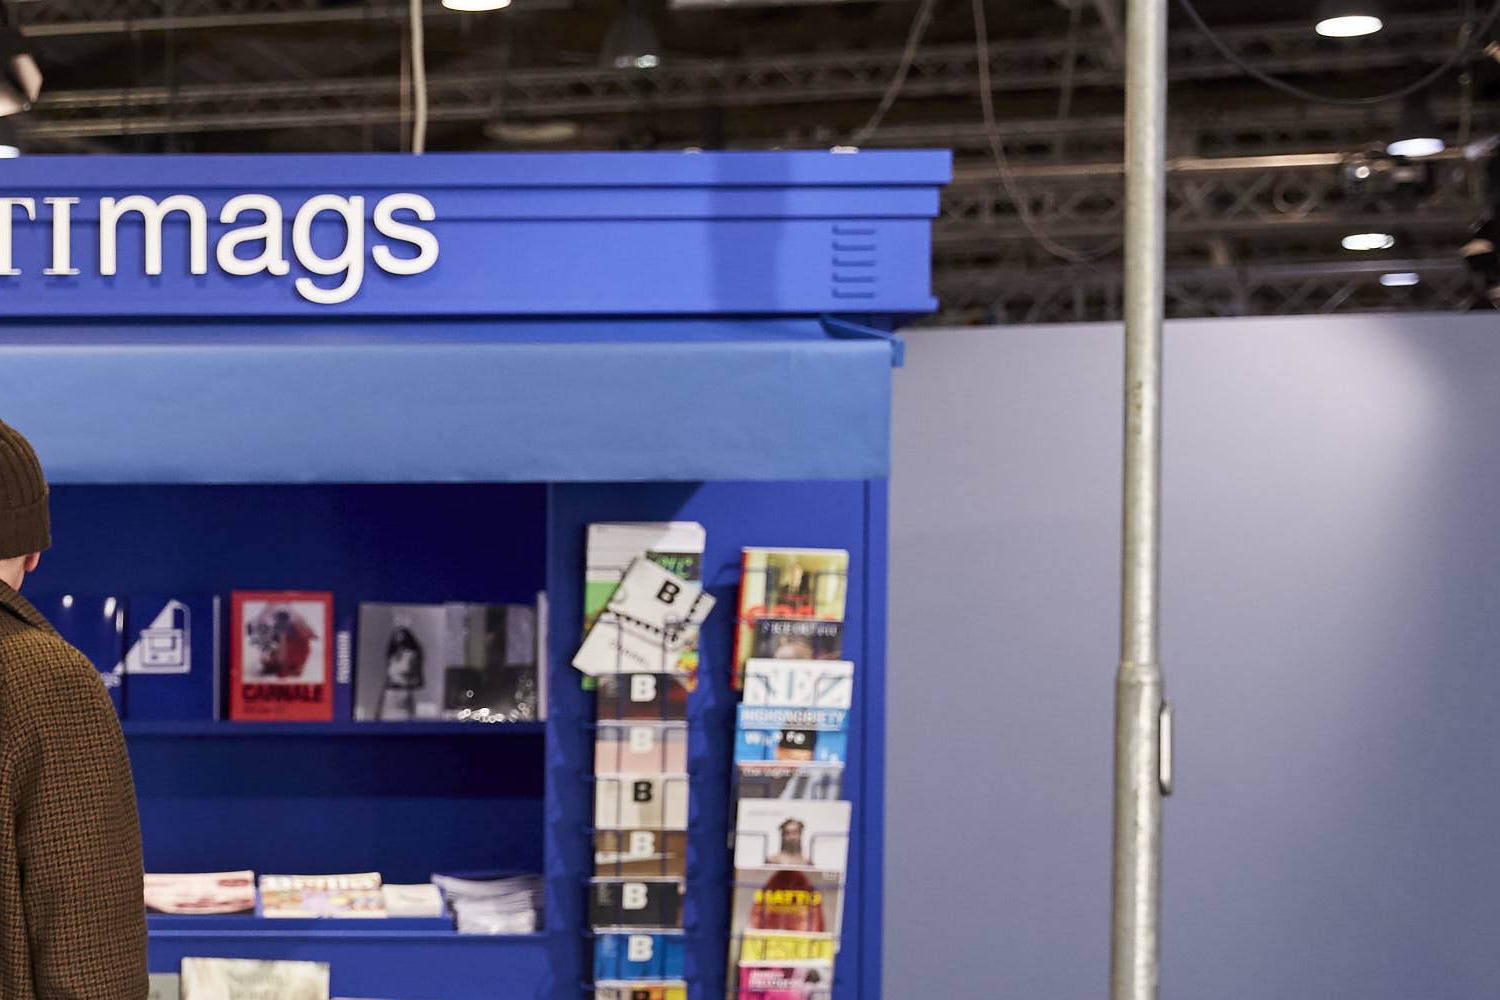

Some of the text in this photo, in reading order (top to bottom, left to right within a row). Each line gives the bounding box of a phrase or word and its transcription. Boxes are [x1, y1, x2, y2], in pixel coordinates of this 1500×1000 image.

[657, 580, 680, 604] B
[630, 674, 657, 702] B
[629, 726, 654, 754] B
[633, 781, 652, 802] B
[629, 831, 655, 858] B
[622, 883, 648, 910] B
[628, 935, 654, 962] B
